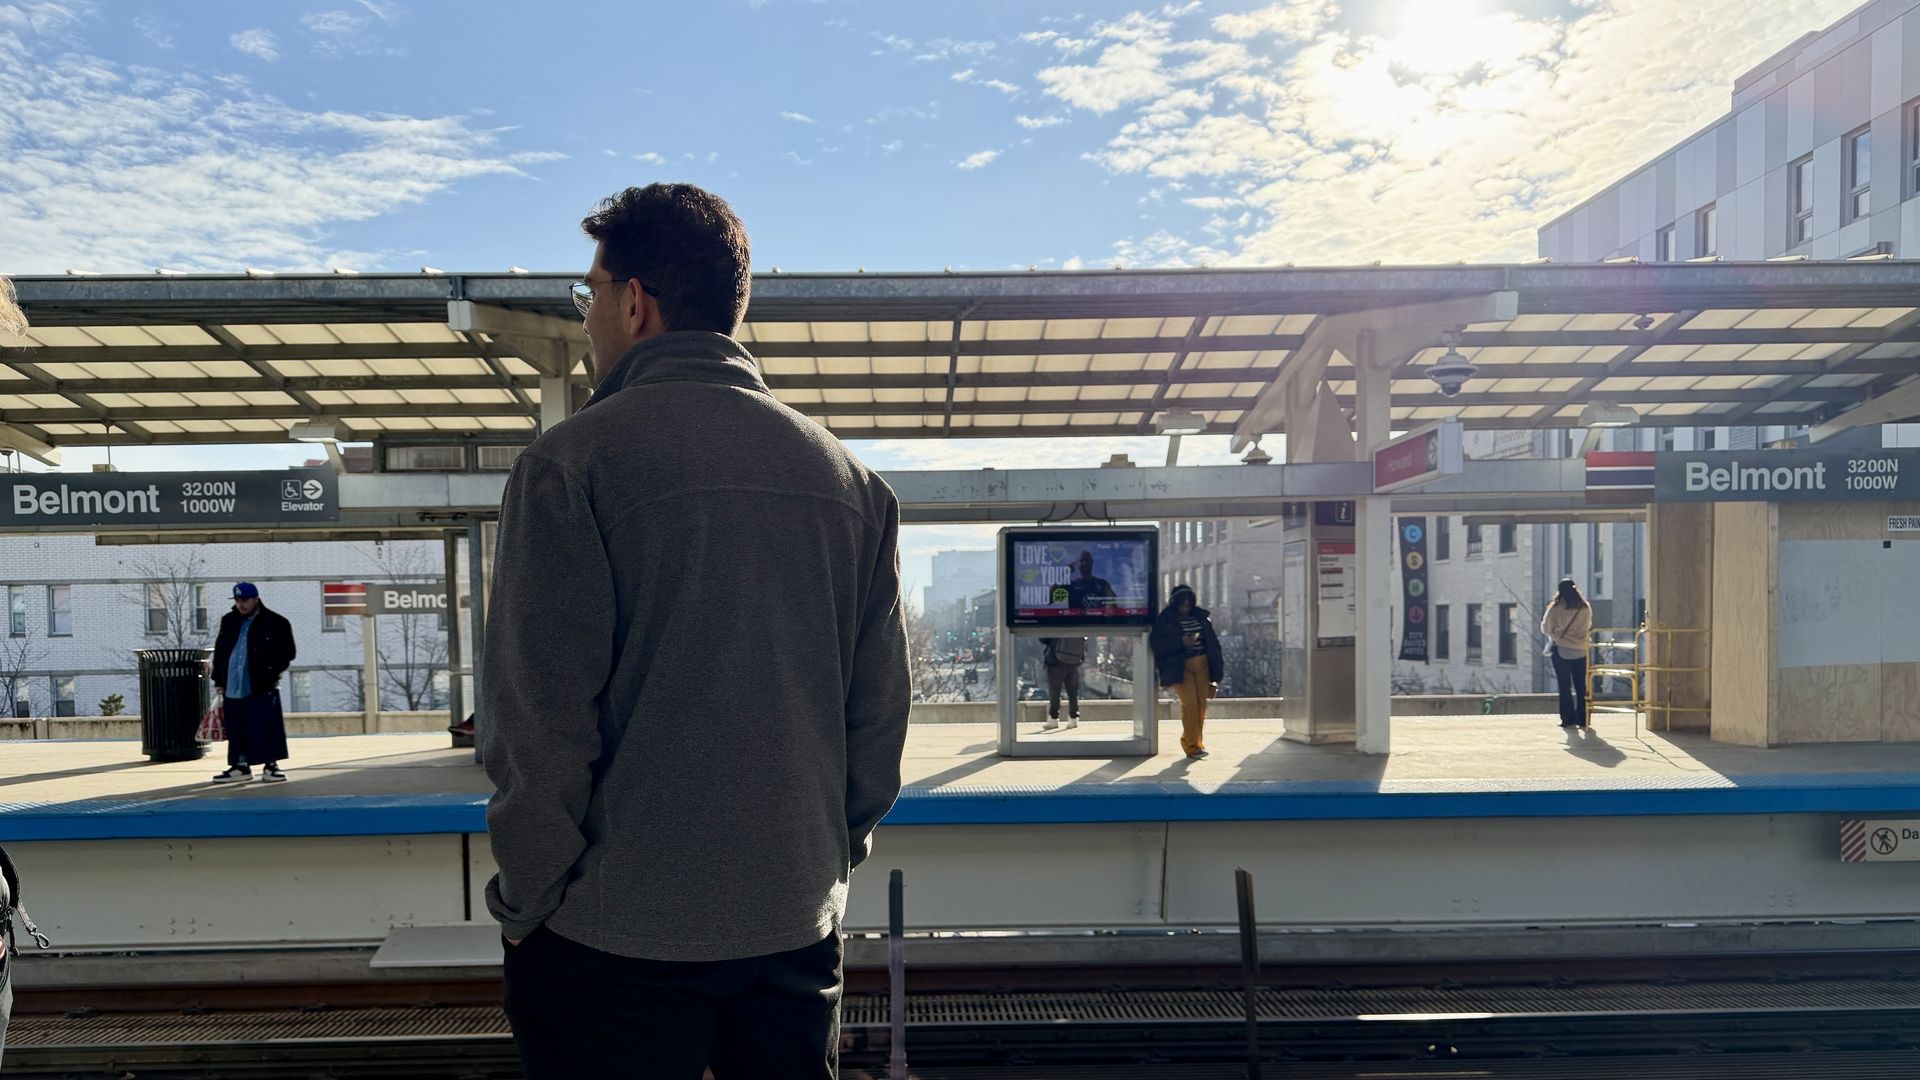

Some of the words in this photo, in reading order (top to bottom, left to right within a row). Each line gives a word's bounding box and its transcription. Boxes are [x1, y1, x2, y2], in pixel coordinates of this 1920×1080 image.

[1847, 458, 1899, 473] 3200N
[1685, 461, 1826, 491] Belmont
[1845, 475, 1898, 490] 1000W
[182, 481, 236, 496] 3200N
[13, 484, 160, 515] Belmont
[180, 498, 236, 513] 1000W
[281, 501, 325, 512] Elevator
[1889, 517, 1907, 529] FRESH
[1040, 566, 1072, 586] YOUR
[1019, 586, 1050, 605] MIND
